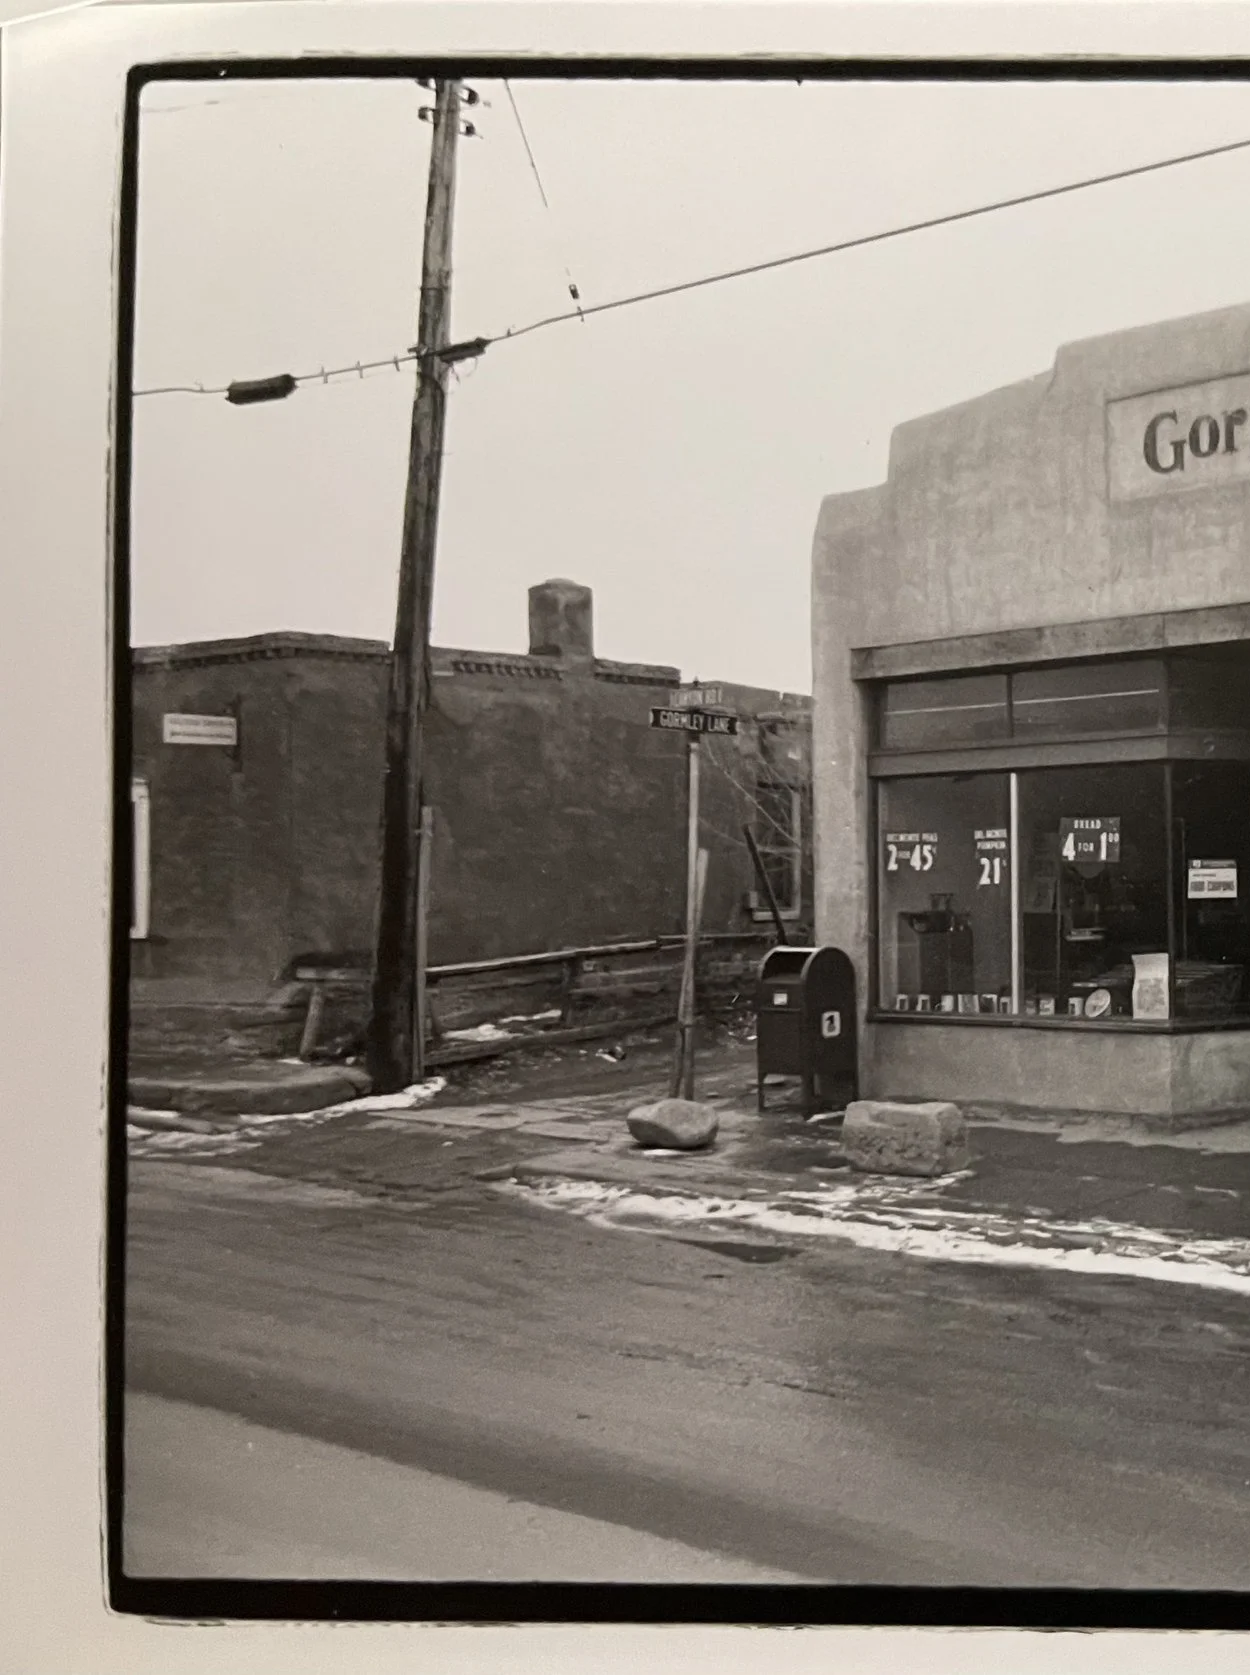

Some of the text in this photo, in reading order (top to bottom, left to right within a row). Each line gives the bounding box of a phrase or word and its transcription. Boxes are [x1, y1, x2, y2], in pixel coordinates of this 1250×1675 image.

[660, 710, 730, 734] GORMLEY LANE
[1074, 819, 1101, 829] BREAD
[887, 844, 899, 871] 2
[1062, 832, 1076, 861] 4
[1078, 842, 1094, 852] FOR
